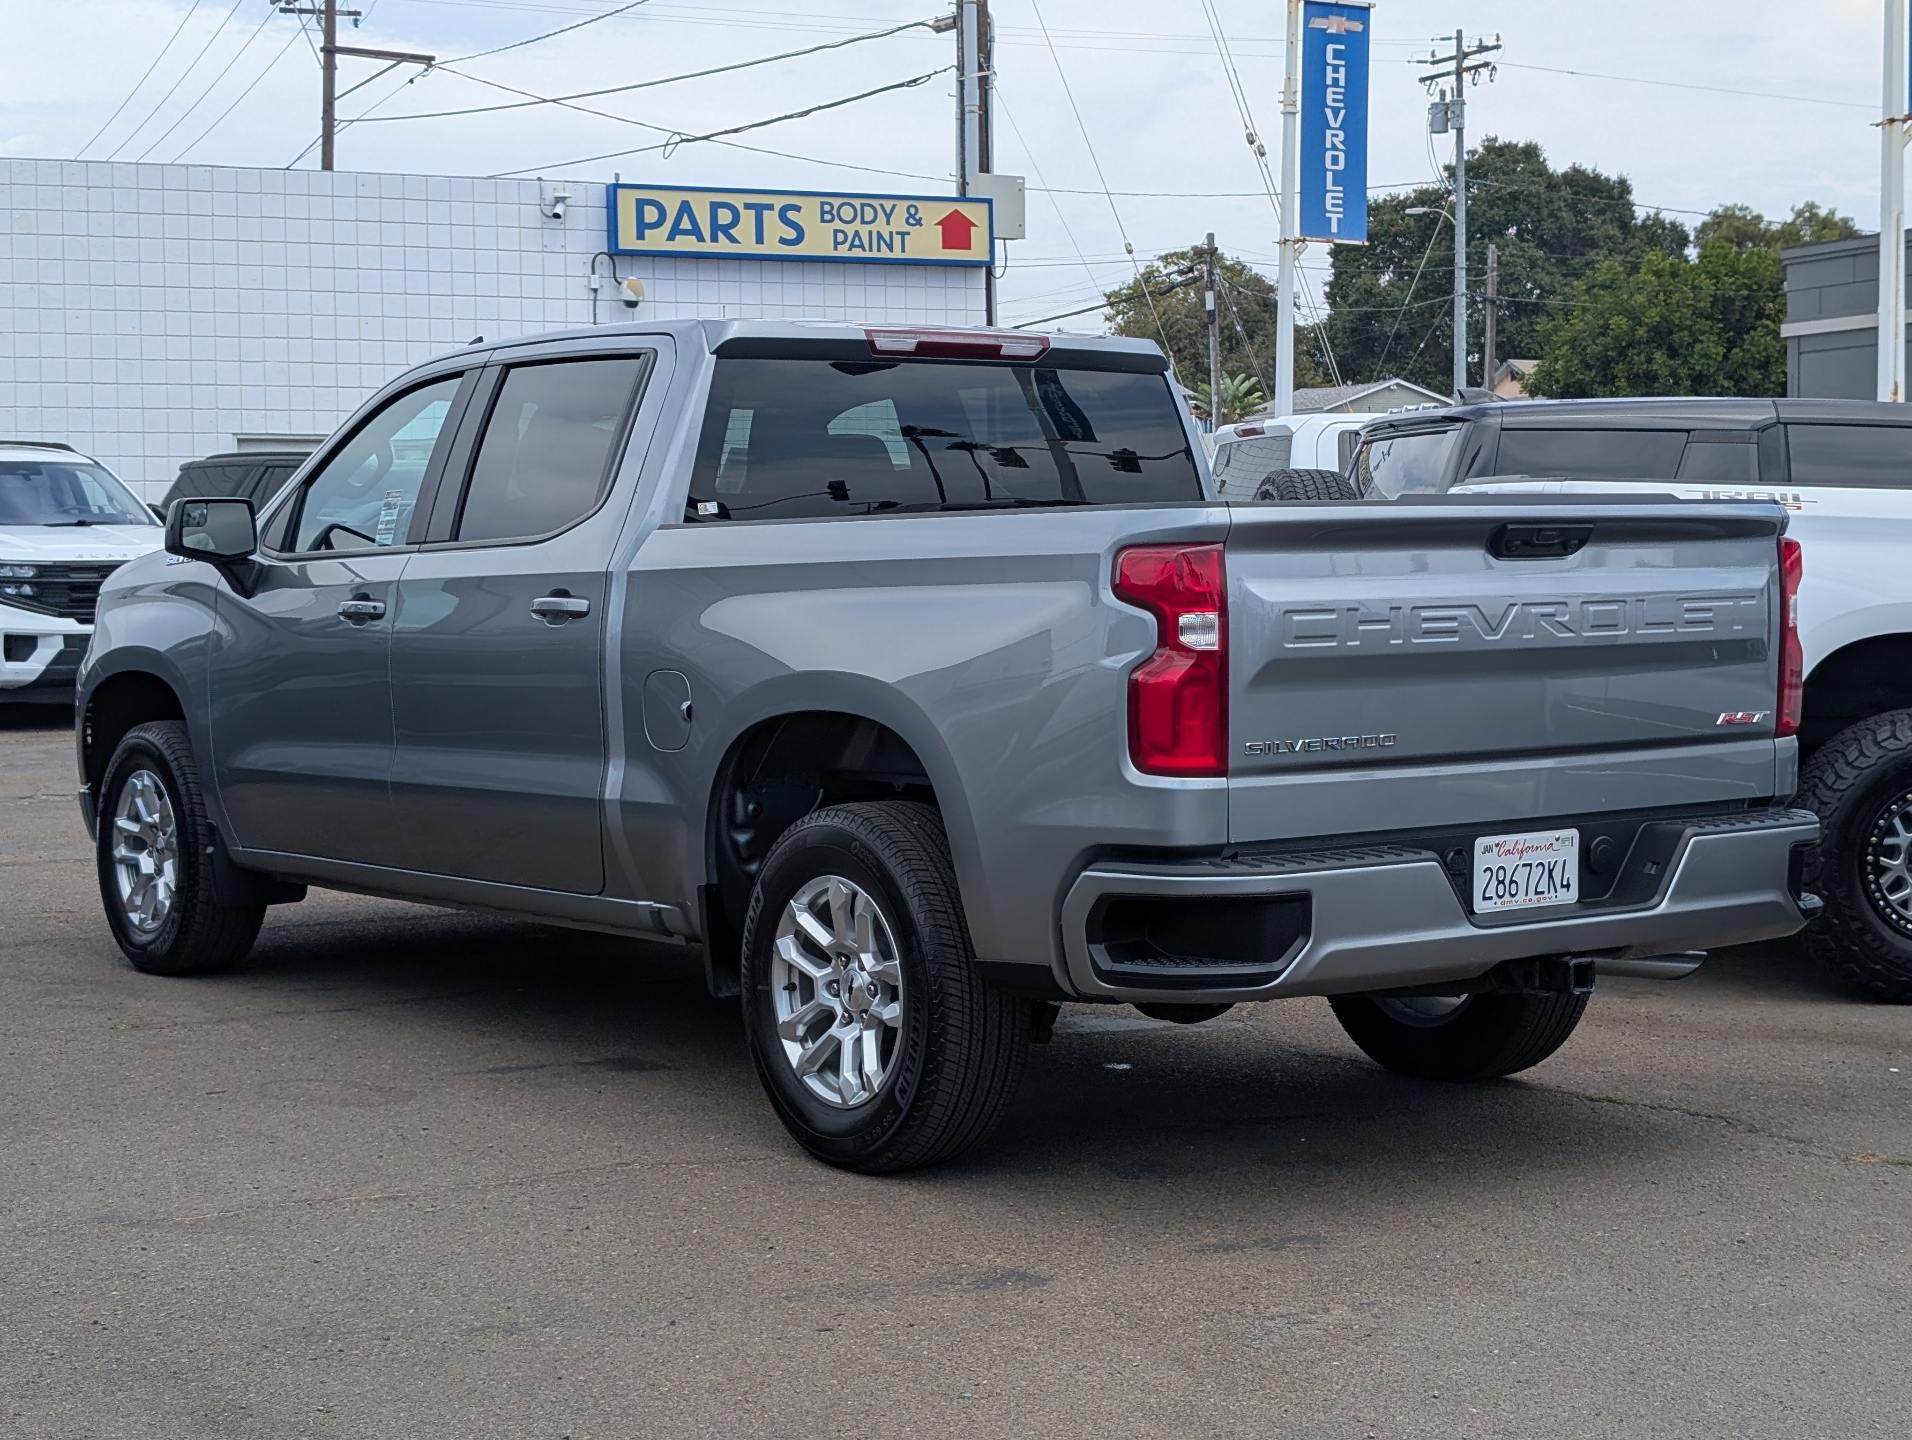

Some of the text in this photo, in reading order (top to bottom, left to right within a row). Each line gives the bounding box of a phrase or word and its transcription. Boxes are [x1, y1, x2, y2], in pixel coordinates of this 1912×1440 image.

[1324, 43, 1347, 233] CHEVROLET
[634, 197, 806, 247] PARTS
[818, 200, 924, 227] BODY &
[832, 228, 911, 254] PAINT
[1283, 595, 1757, 649] CHEVROLET
[1715, 710, 1771, 725] RST
[1244, 733, 1398, 756] SILVERADO
[1481, 843, 1494, 855] JAN
[1496, 838, 1561, 861] California
[1481, 857, 1572, 902] 28672K4
[1499, 895, 1553, 906] dmv.ca.gov
[897, 991, 922, 1102] MICHELIN
